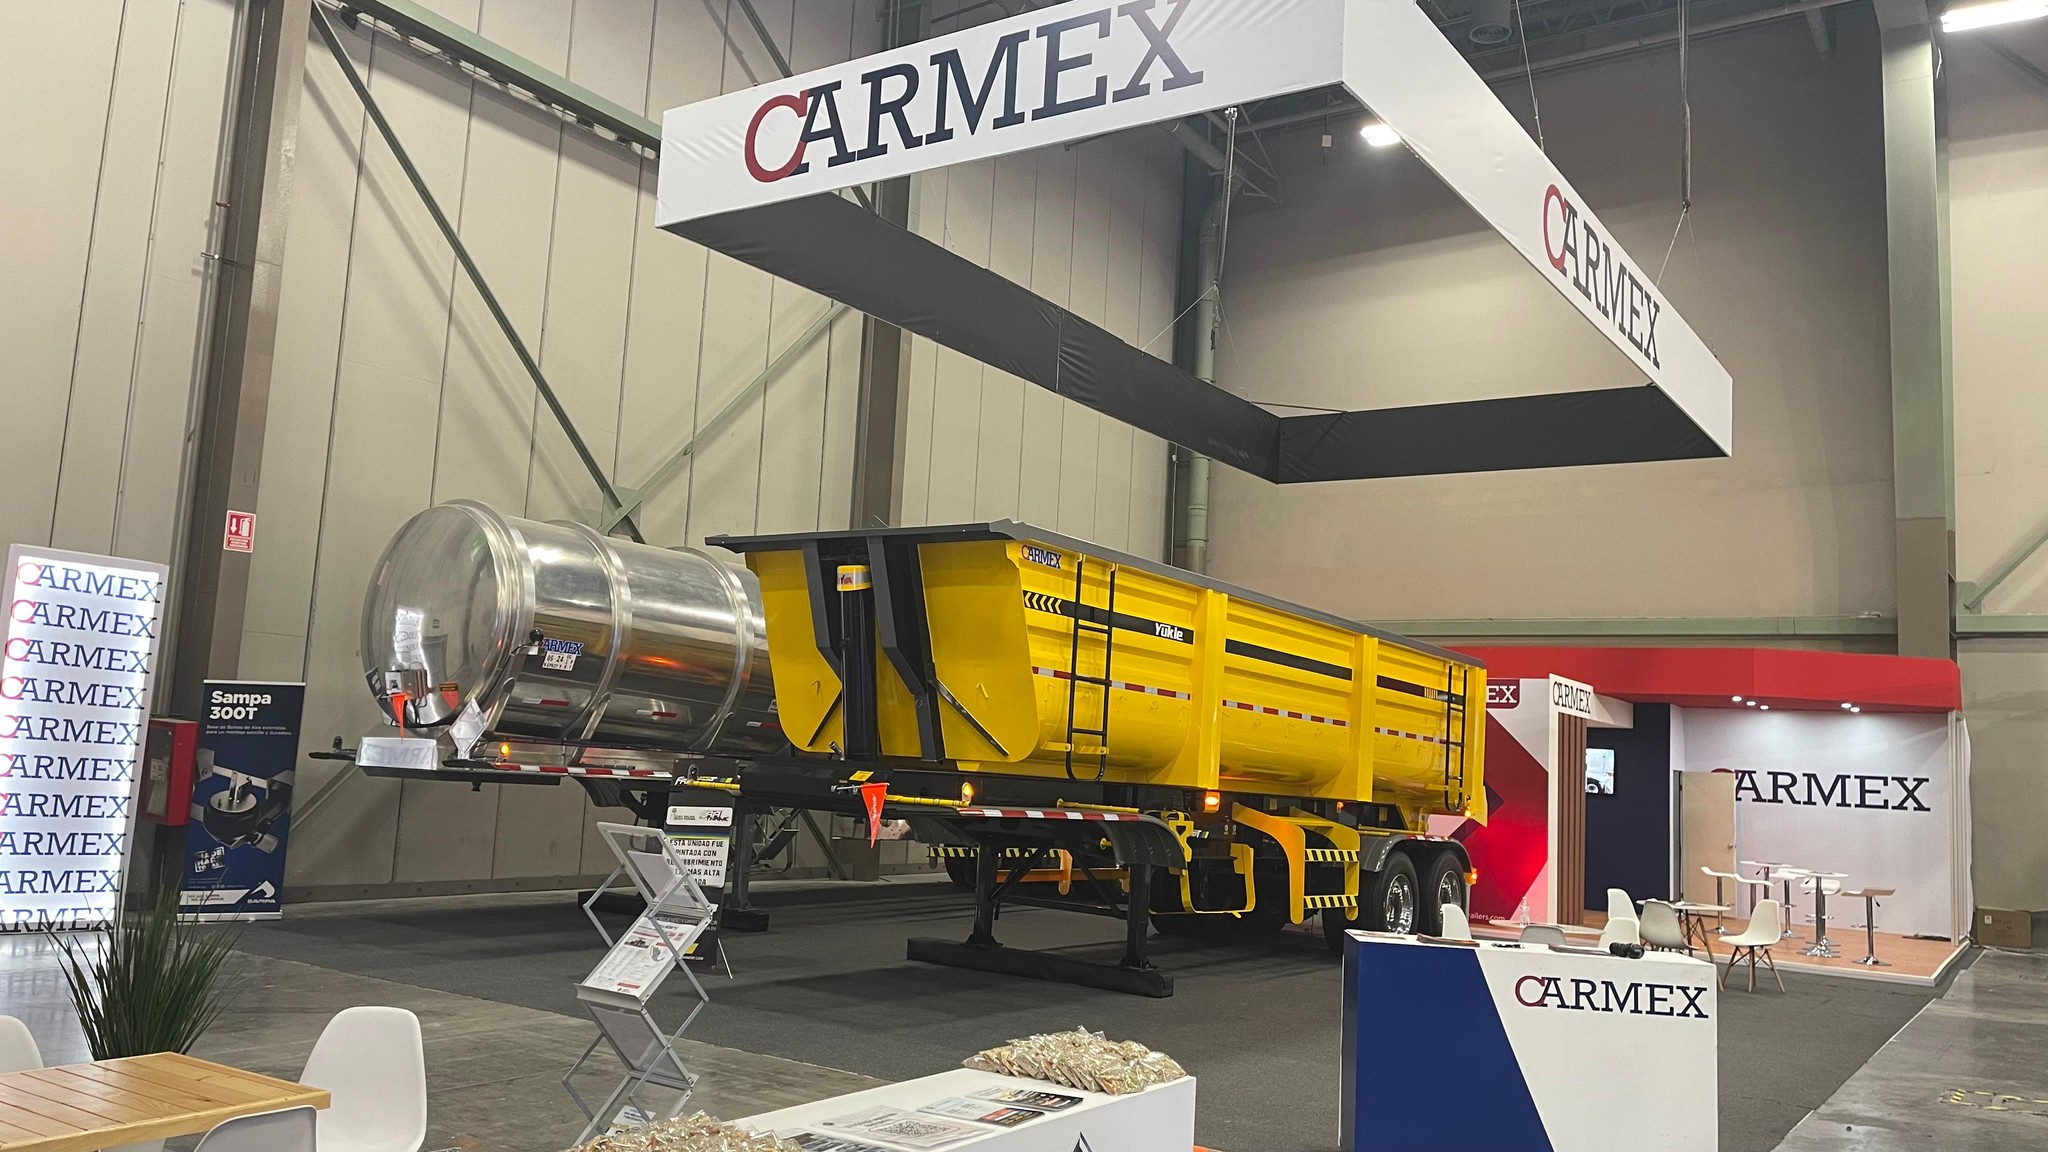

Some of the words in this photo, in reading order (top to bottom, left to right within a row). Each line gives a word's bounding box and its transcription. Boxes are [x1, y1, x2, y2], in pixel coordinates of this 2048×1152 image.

[744, 0, 1204, 183] CARMEX
[1543, 184, 1660, 370] CARMEX
[1022, 545, 1061, 569] CARMEX
[17, 562, 163, 604] CARMEX
[11, 599, 157, 639] CARMEX
[5, 637, 152, 674] CARMEX
[543, 638, 584, 656] ARMEX
[0, 676, 147, 710] CARMEX
[211, 690, 271, 706] Sampa
[1487, 685, 1517, 704] EX
[1553, 681, 1591, 714] CARMEX
[209, 706, 258, 720] 300T
[0, 715, 142, 746] CARMEX
[1711, 768, 1931, 812] ARMEX
[0, 832, 127, 856] ARMEX
[0, 870, 121, 893] ARMEX
[703, 869, 720, 877] ALTA
[0, 907, 116, 933] RMEX
[1515, 975, 1709, 1019] CARMEX
